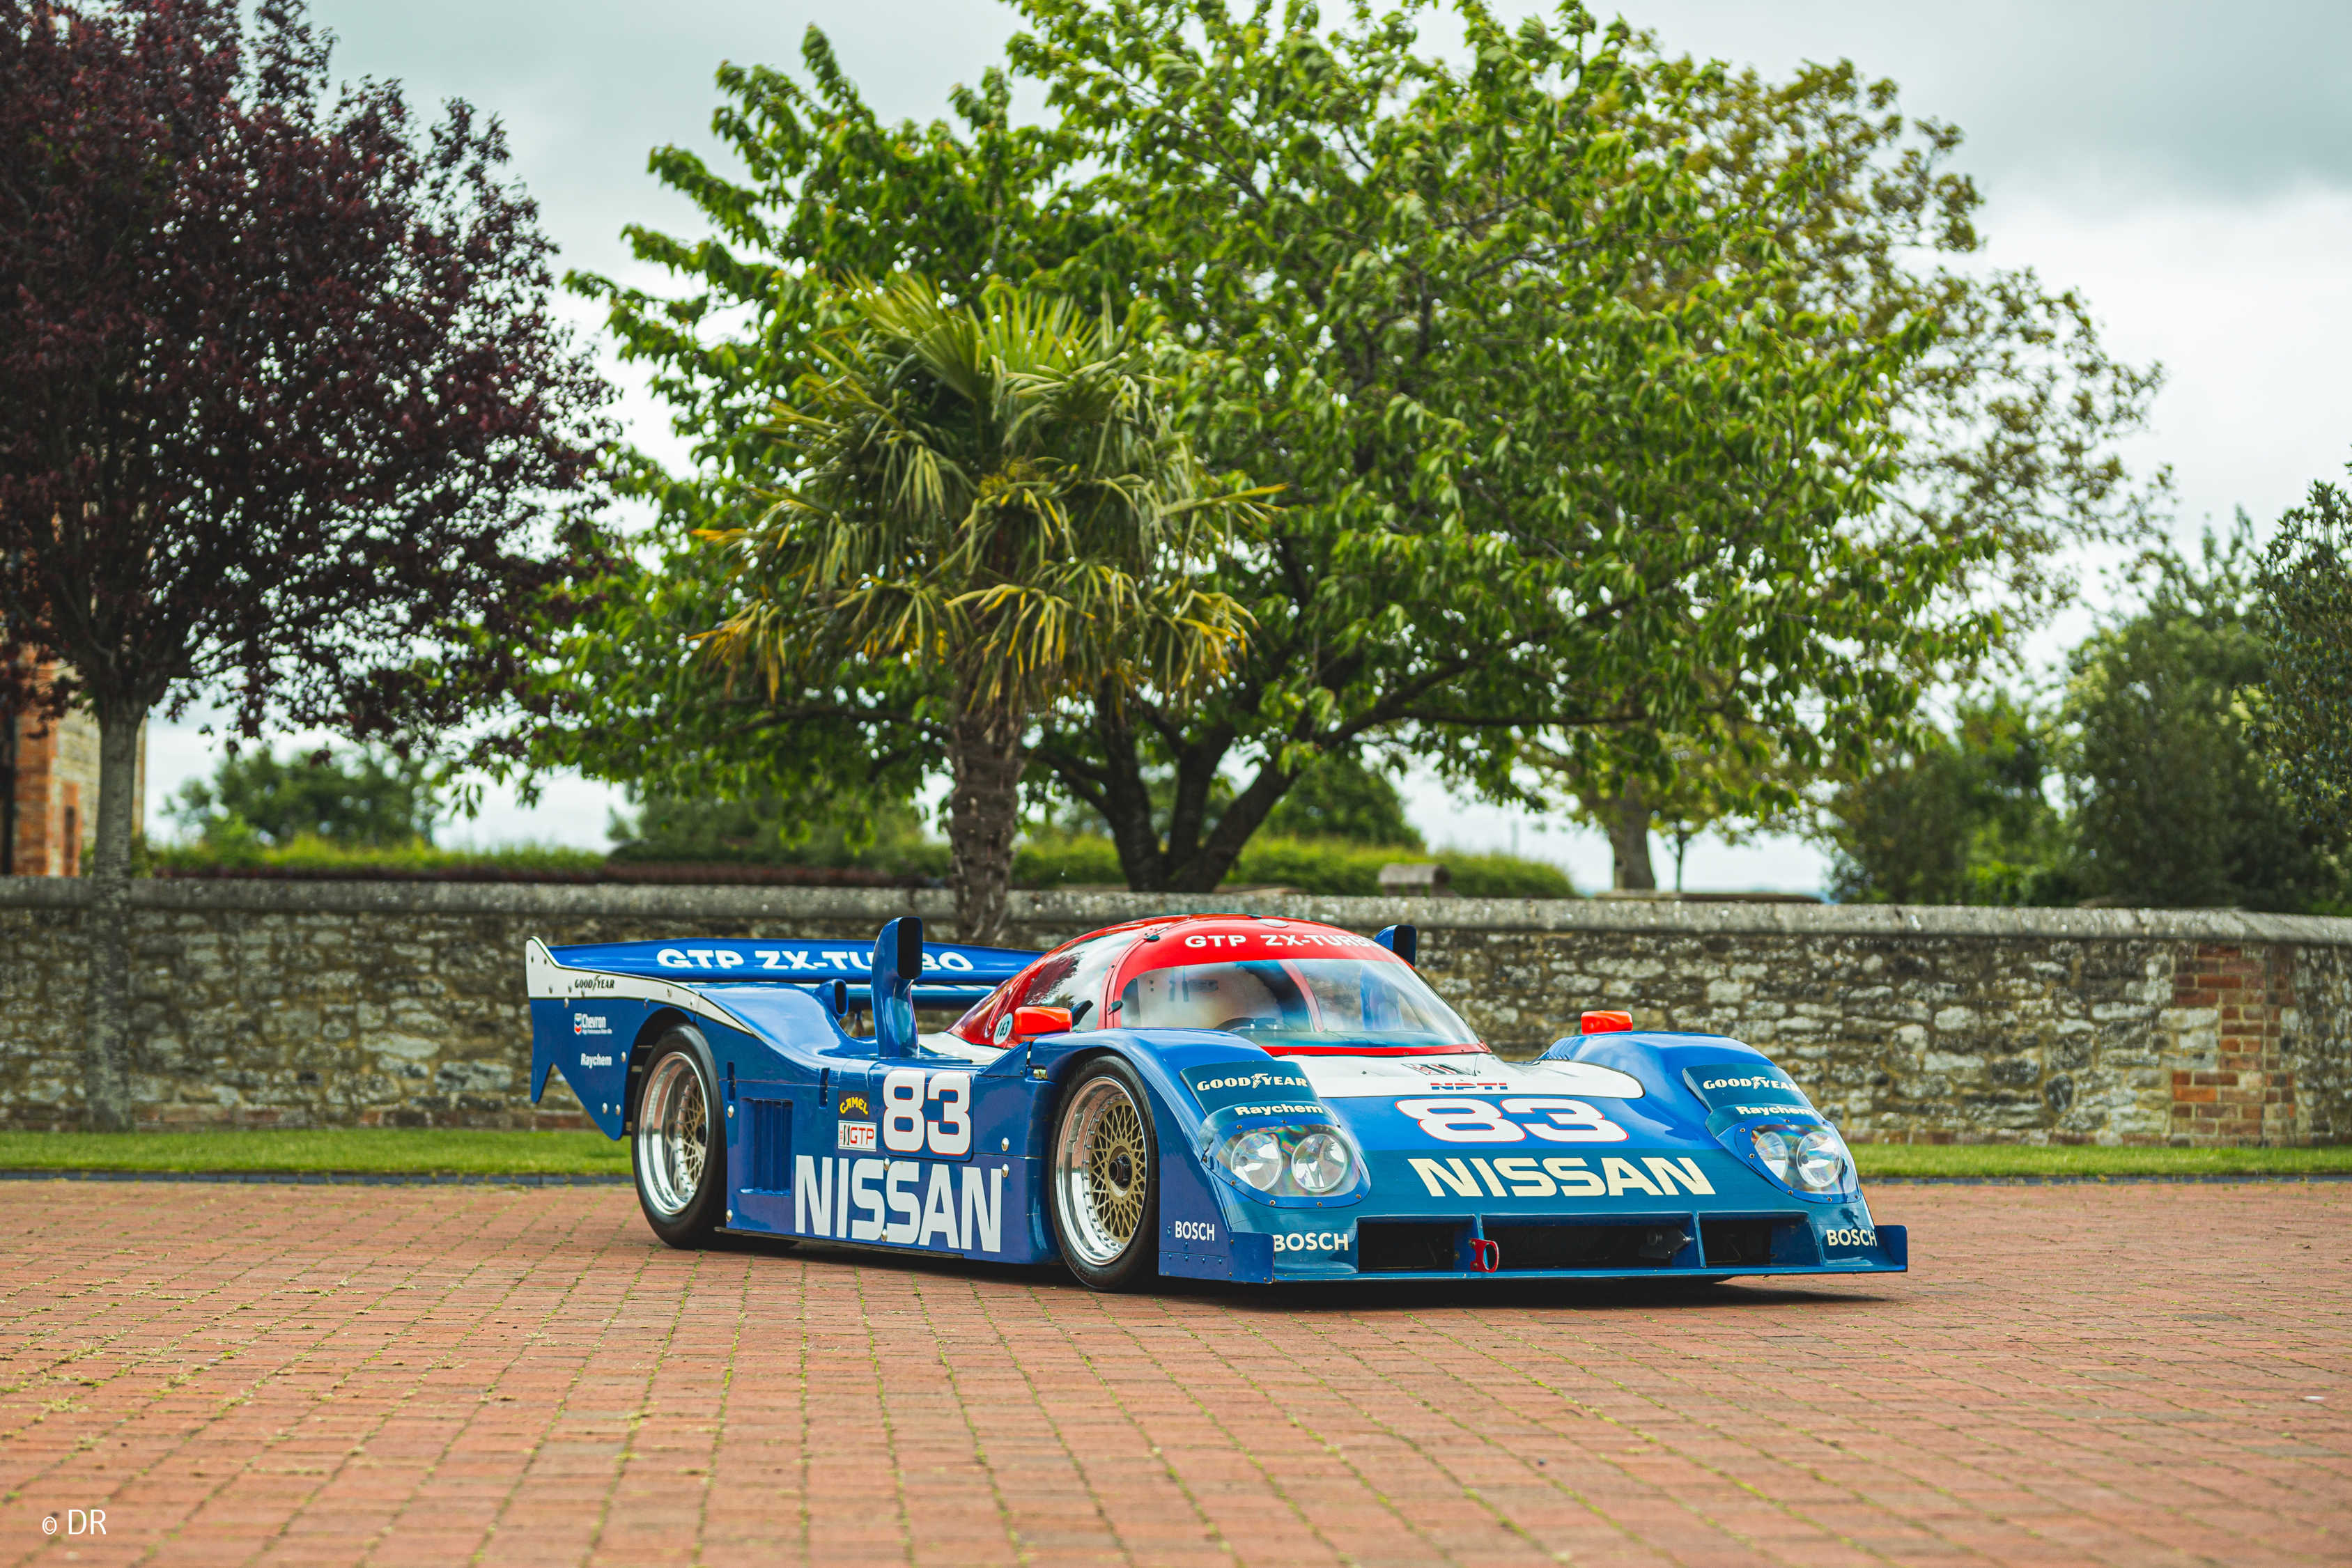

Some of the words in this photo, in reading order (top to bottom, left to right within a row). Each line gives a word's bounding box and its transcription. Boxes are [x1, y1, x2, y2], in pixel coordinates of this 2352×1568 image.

[1184, 935, 1247, 947] GTP
[656, 948, 745, 969] GTP
[754, 949, 975, 972] ZX-TUBO
[996, 1020, 1010, 1037] 163
[580, 1053, 612, 1069] Raychem
[840, 1096, 869, 1115] CAMEL
[883, 1069, 971, 1156] 83
[1235, 1103, 1324, 1116] Raychem
[1735, 1105, 1815, 1116] Raychem
[1395, 1099, 1629, 1142] 83
[850, 1126, 874, 1145] GTP
[1407, 1157, 1716, 1197] NISSAN
[795, 1154, 1002, 1252] NISSAN
[1175, 1220, 1215, 1241] BOSCH
[1826, 1229, 1878, 1247] BOSCH
[1273, 1232, 1349, 1252] BOSCH
